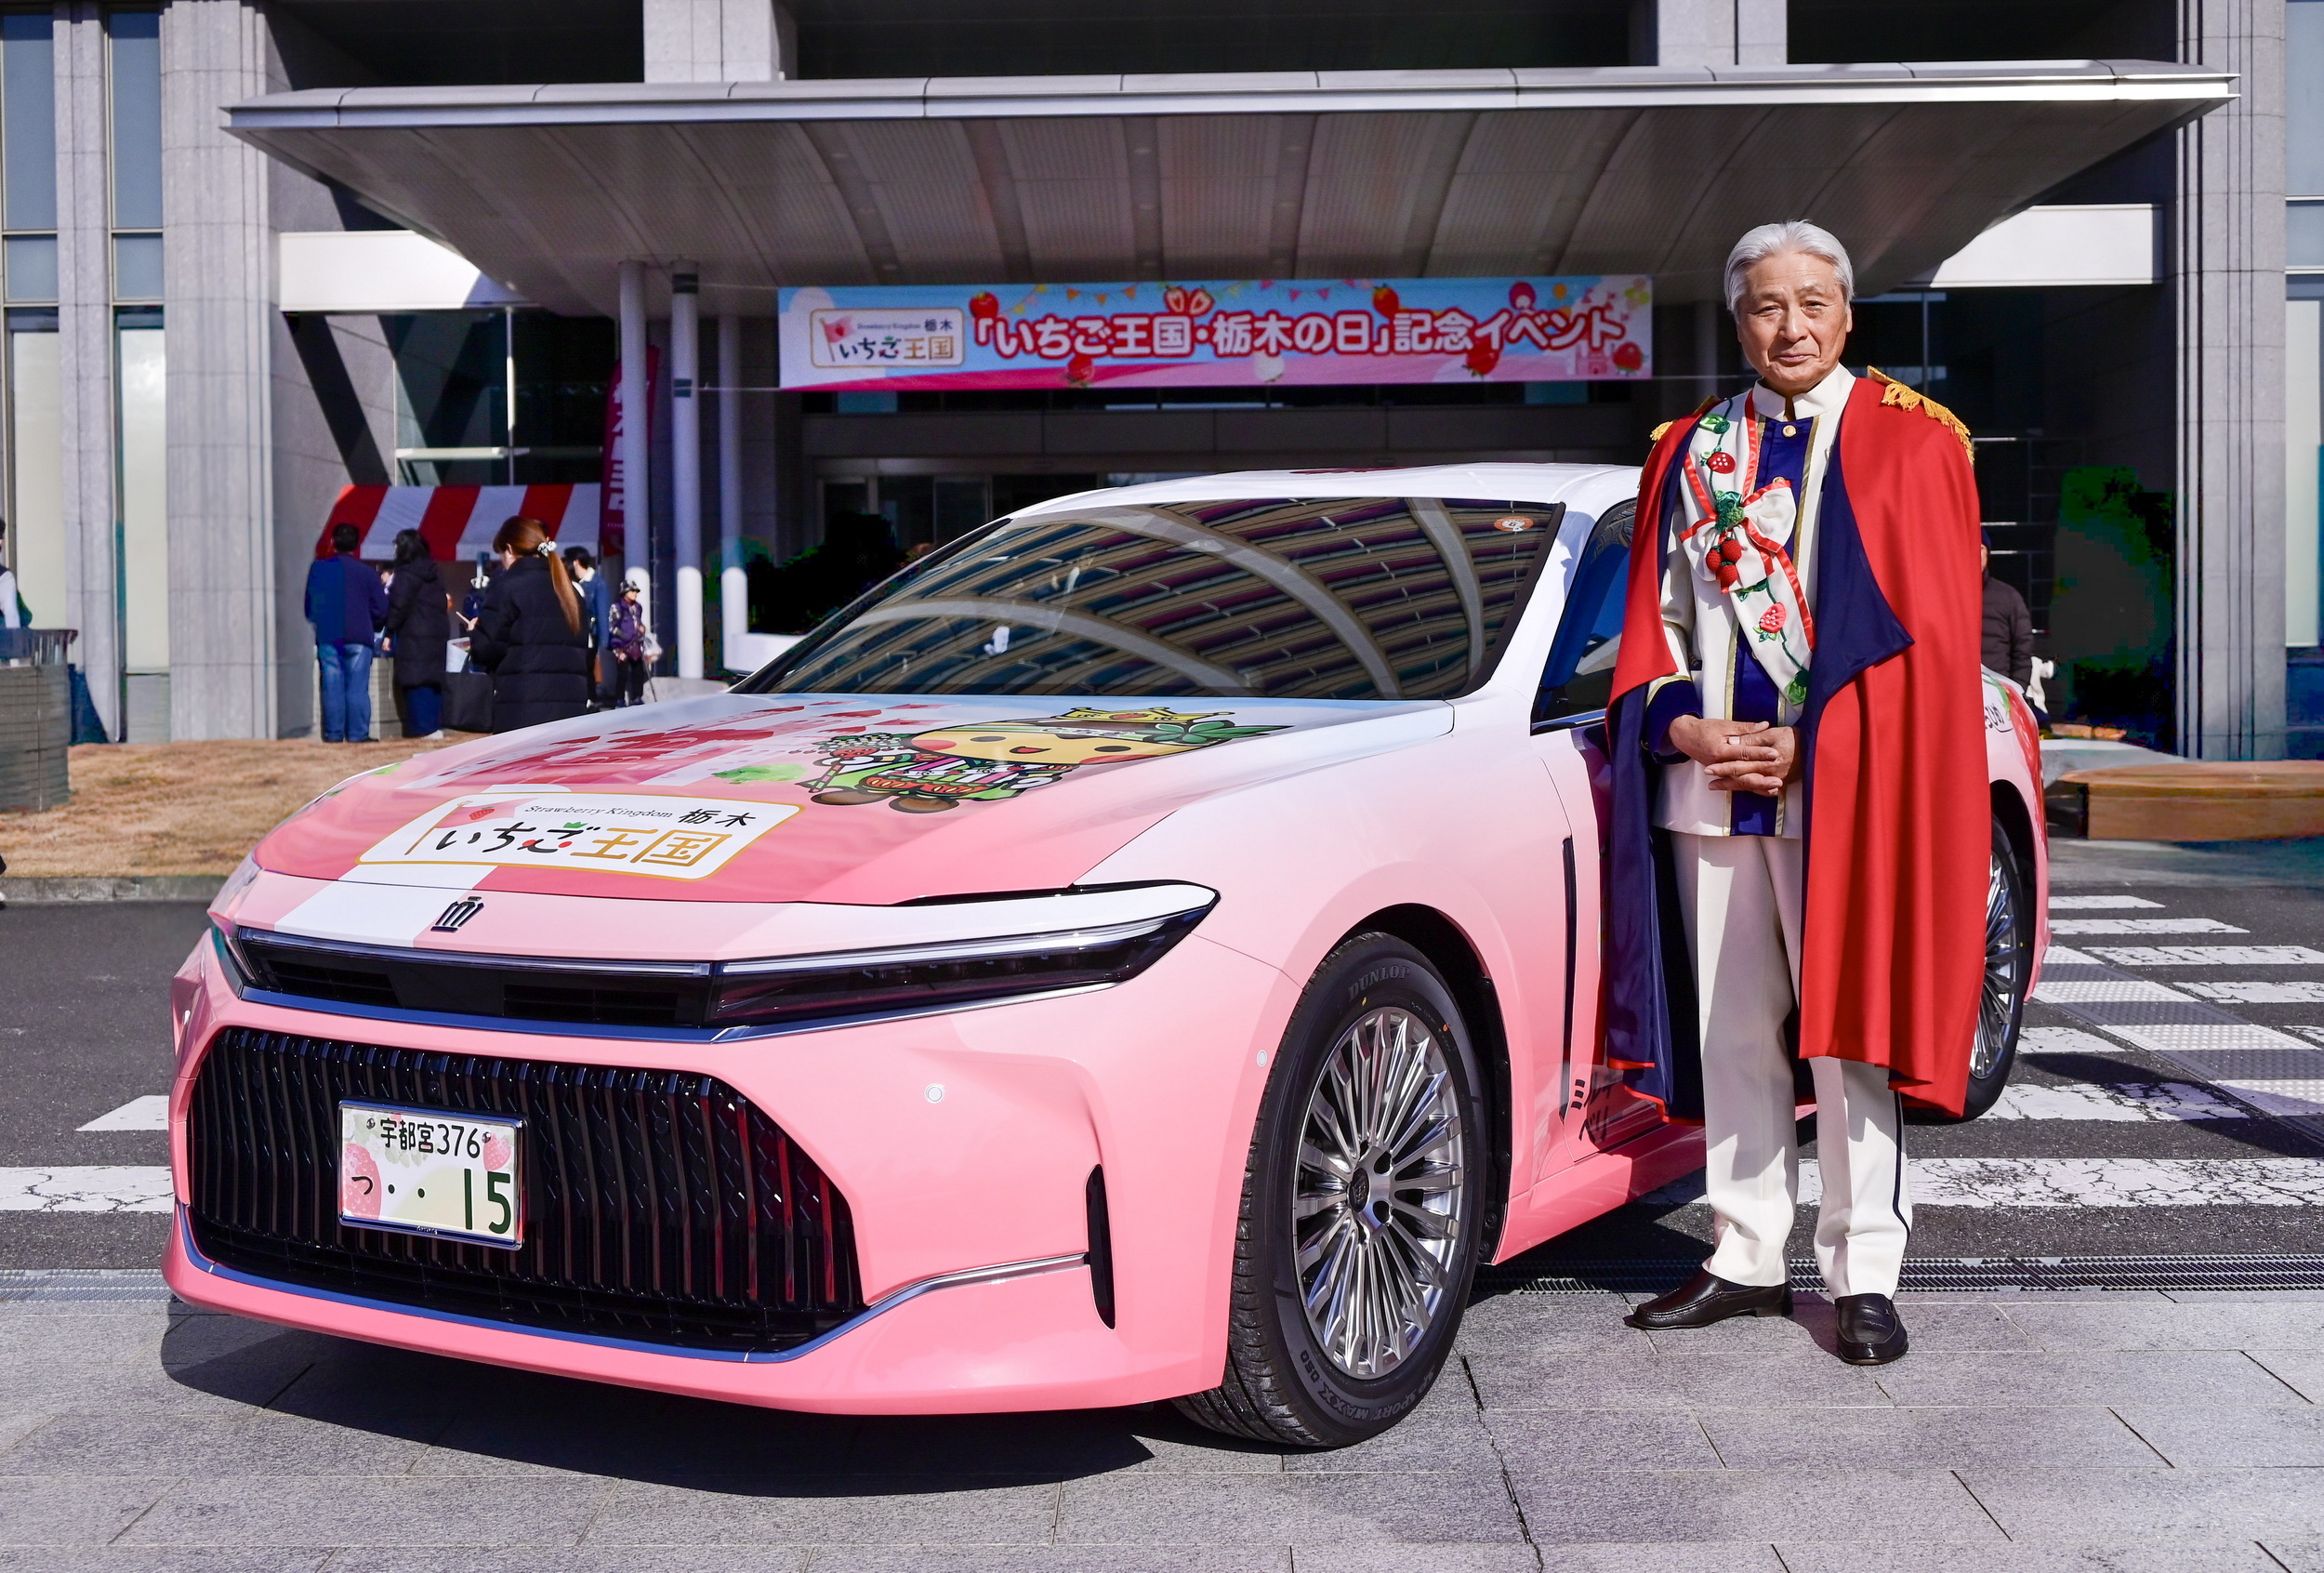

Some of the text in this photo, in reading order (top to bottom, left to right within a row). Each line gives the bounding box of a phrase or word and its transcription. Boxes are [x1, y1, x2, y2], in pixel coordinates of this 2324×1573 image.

[838, 335, 954, 361] いちご王国
[974, 307, 1625, 359] 「いちご王国・栃木の日」記念イベント
[525, 805, 757, 828] Strawberry Kingdom 栃木
[436, 821, 733, 867] いちご王国
[1348, 965, 1410, 1003] DUNLOP
[1300, 1349, 1320, 1383] 050
[1319, 1386, 1369, 1421] MAXX
[1371, 1388, 1418, 1421] SPORT
